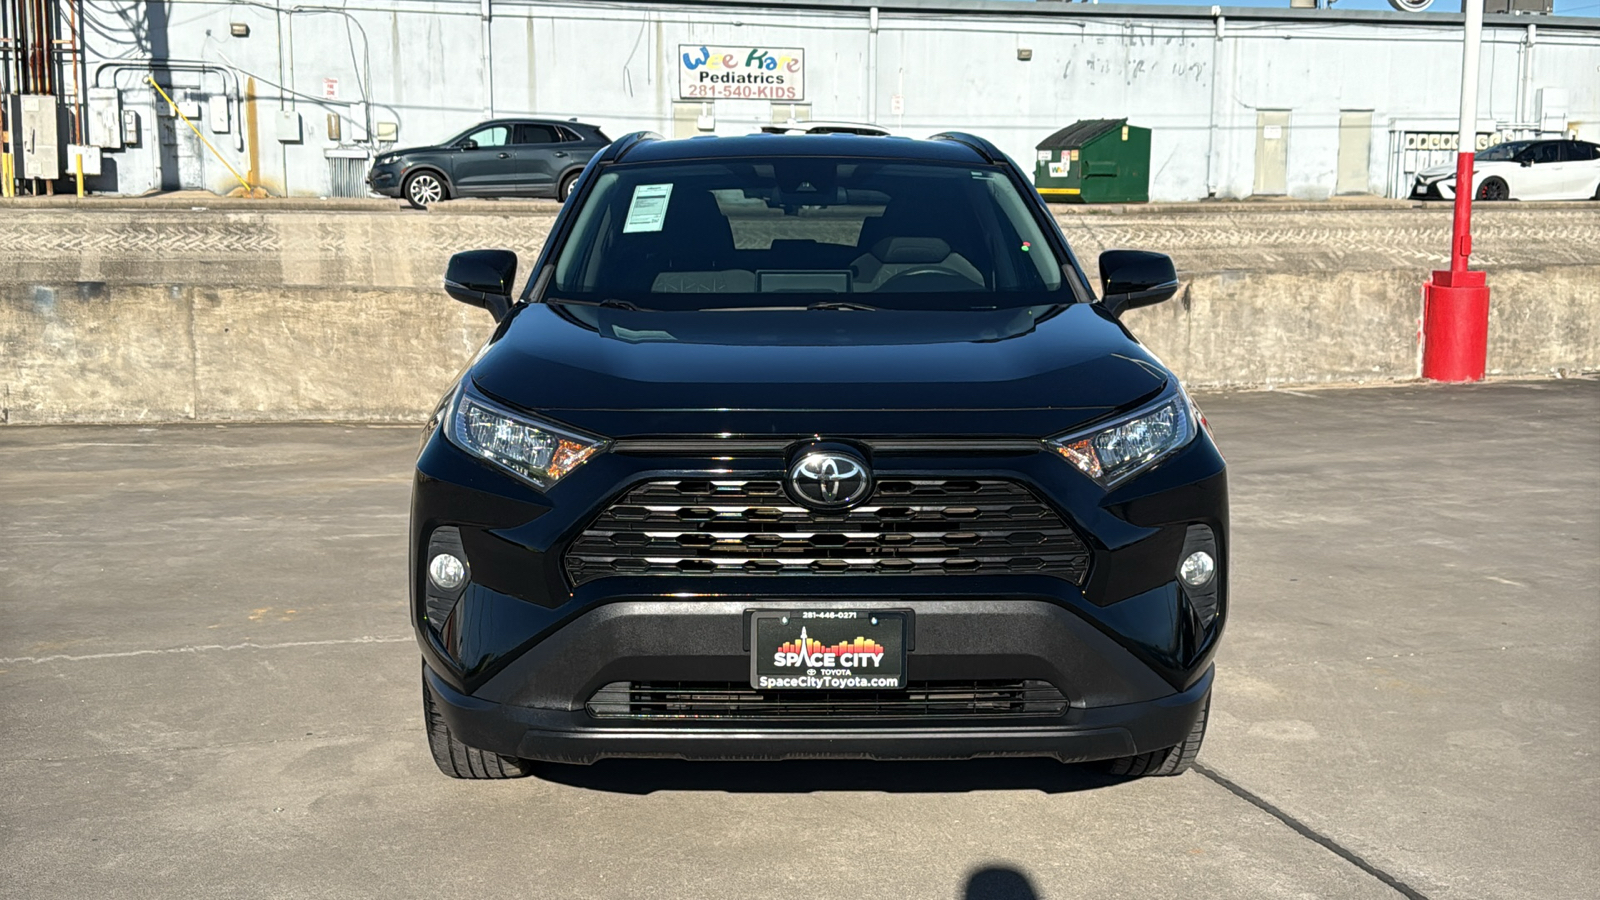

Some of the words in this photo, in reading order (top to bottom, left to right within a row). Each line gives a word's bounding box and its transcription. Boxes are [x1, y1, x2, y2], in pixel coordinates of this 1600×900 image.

[683, 46, 738, 70] Wee
[745, 48, 800, 73] Kare
[700, 71, 784, 84] Pediatrics
[688, 84, 796, 98] 281-540-KIDS
[802, 611, 857, 619] 281-446-0271
[774, 645, 836, 667] SPACE
[840, 652, 884, 667] CITY
[759, 676, 898, 689] SpaceCityToyota.com
